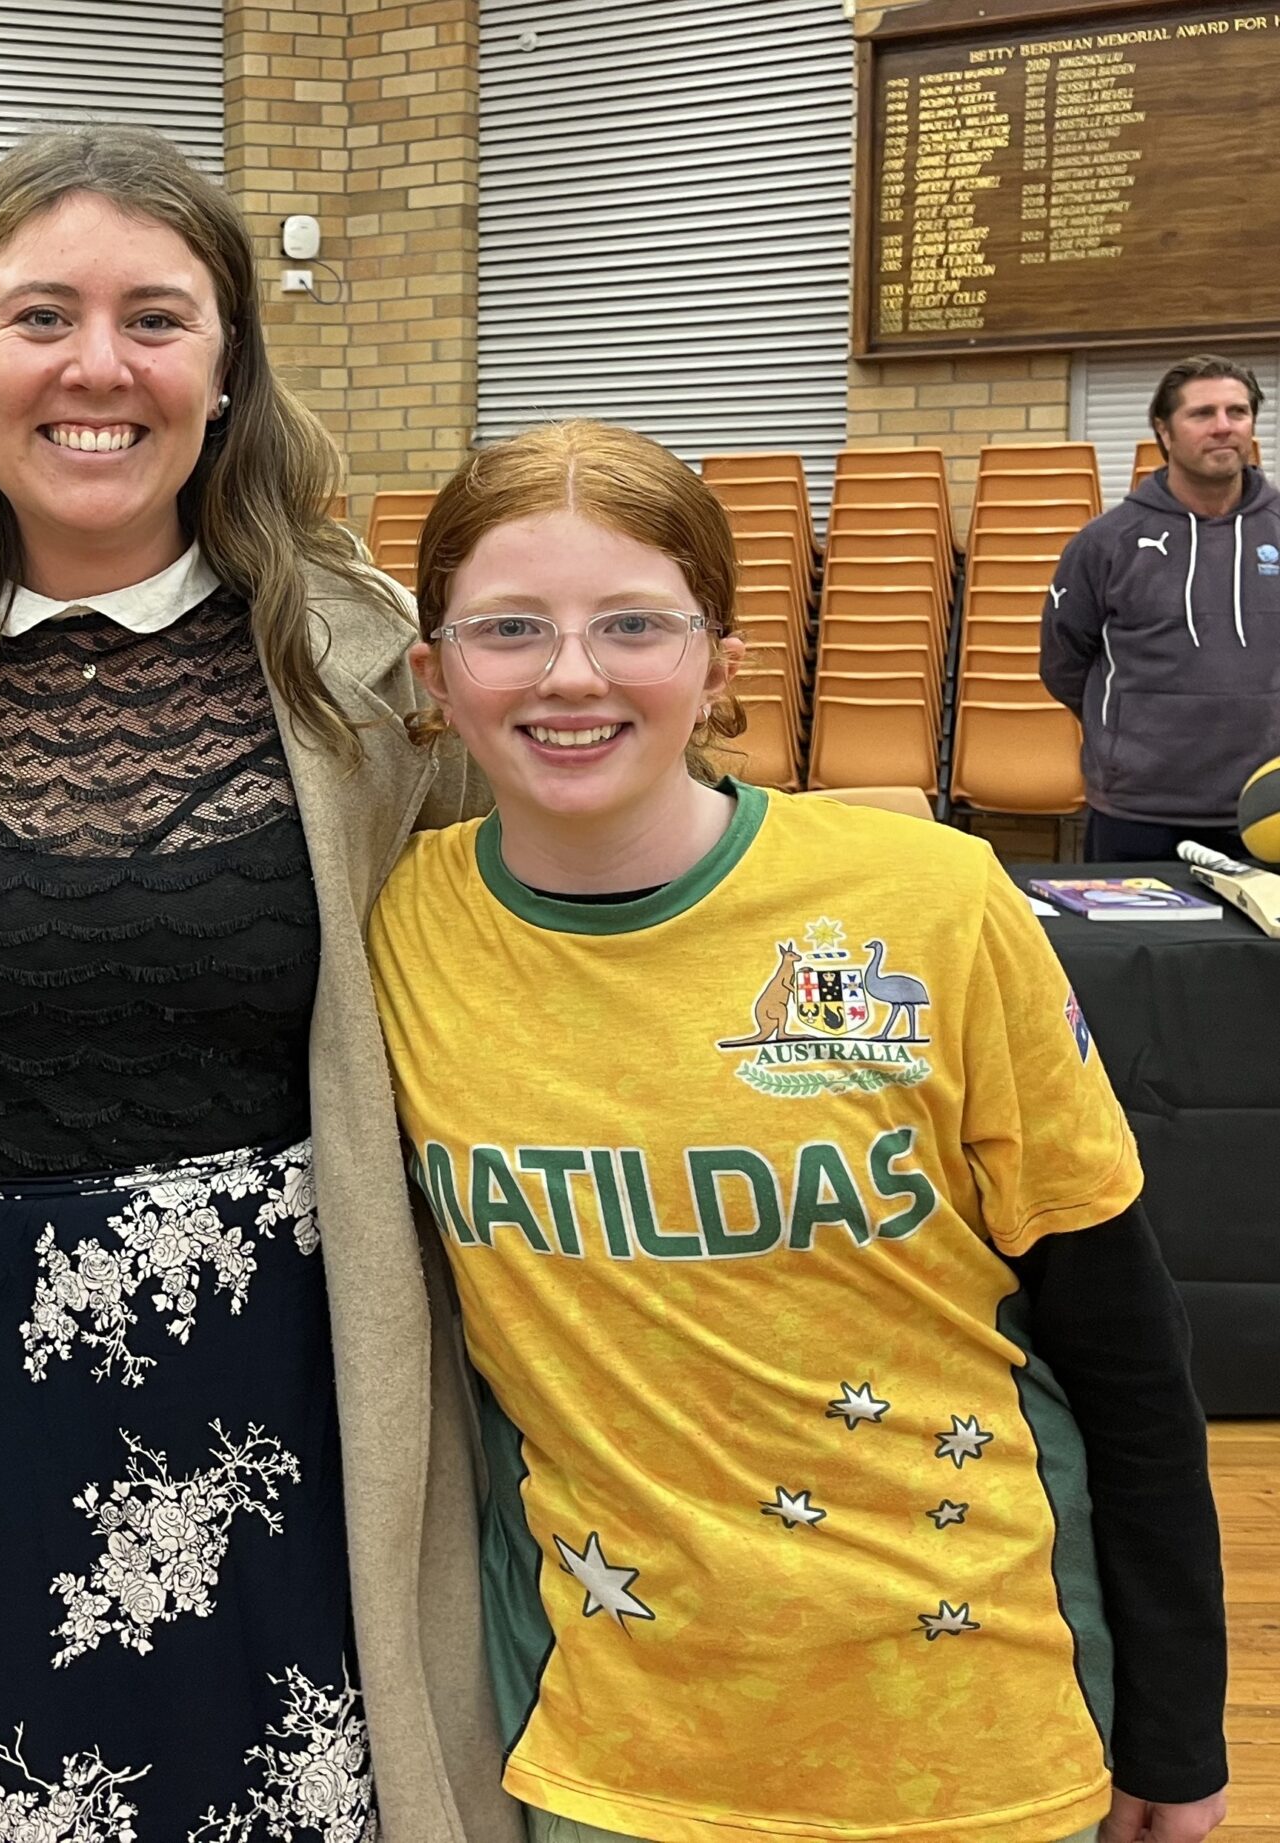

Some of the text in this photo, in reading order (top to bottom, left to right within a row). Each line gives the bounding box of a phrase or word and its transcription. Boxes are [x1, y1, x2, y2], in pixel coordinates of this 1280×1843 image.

[969, 47, 1016, 63] BETTY
[1020, 37, 1093, 57] BERRIMAN
[1096, 28, 1171, 49] MEMORIAL
[1176, 21, 1229, 39] AWARD
[1234, 17, 1267, 31] FOR
[756, 1042, 912, 1065] AUSTRALIA
[410, 1126, 938, 1260] MATILDAS
